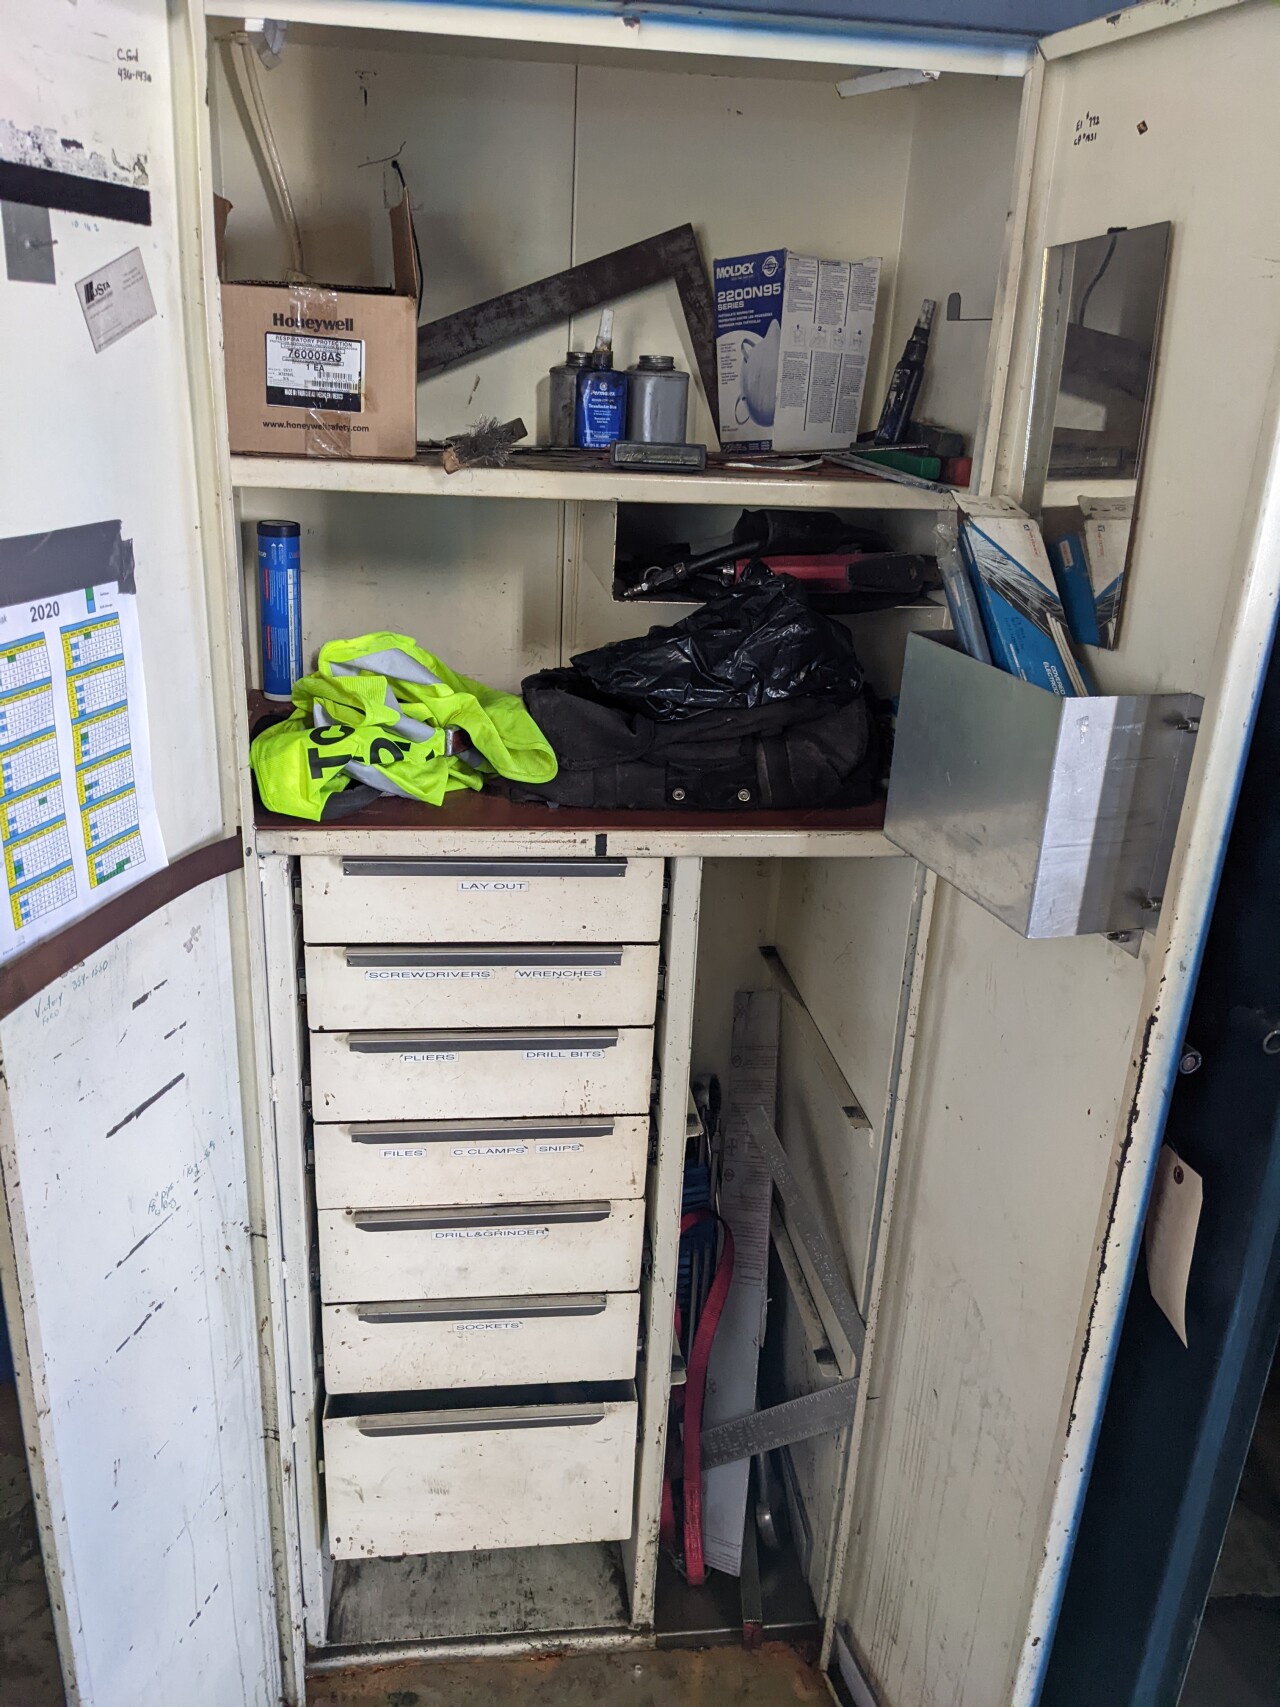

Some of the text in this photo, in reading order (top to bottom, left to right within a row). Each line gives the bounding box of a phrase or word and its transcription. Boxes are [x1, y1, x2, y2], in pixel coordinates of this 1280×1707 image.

[716, 262, 755, 279] MOLDEX
[717, 283, 782, 303] 2200N95
[717, 301, 745, 311] SERIES
[272, 313, 354, 332] Honeywell
[287, 349, 342, 362] 760008AS
[313, 364, 325, 372] EA
[30, 601, 60, 623] 2020
[1050, 665, 1066, 695] COVERED
[368, 970, 491, 979] SCREWDRIVERS
[570, 1050, 602, 1058] BITS
[467, 1147, 525, 1155] CLAMPS
[539, 1144, 581, 1152] SNIPS
[383, 1149, 423, 1157] FILES
[435, 1229, 545, 1238] DRILL&GRINDER
